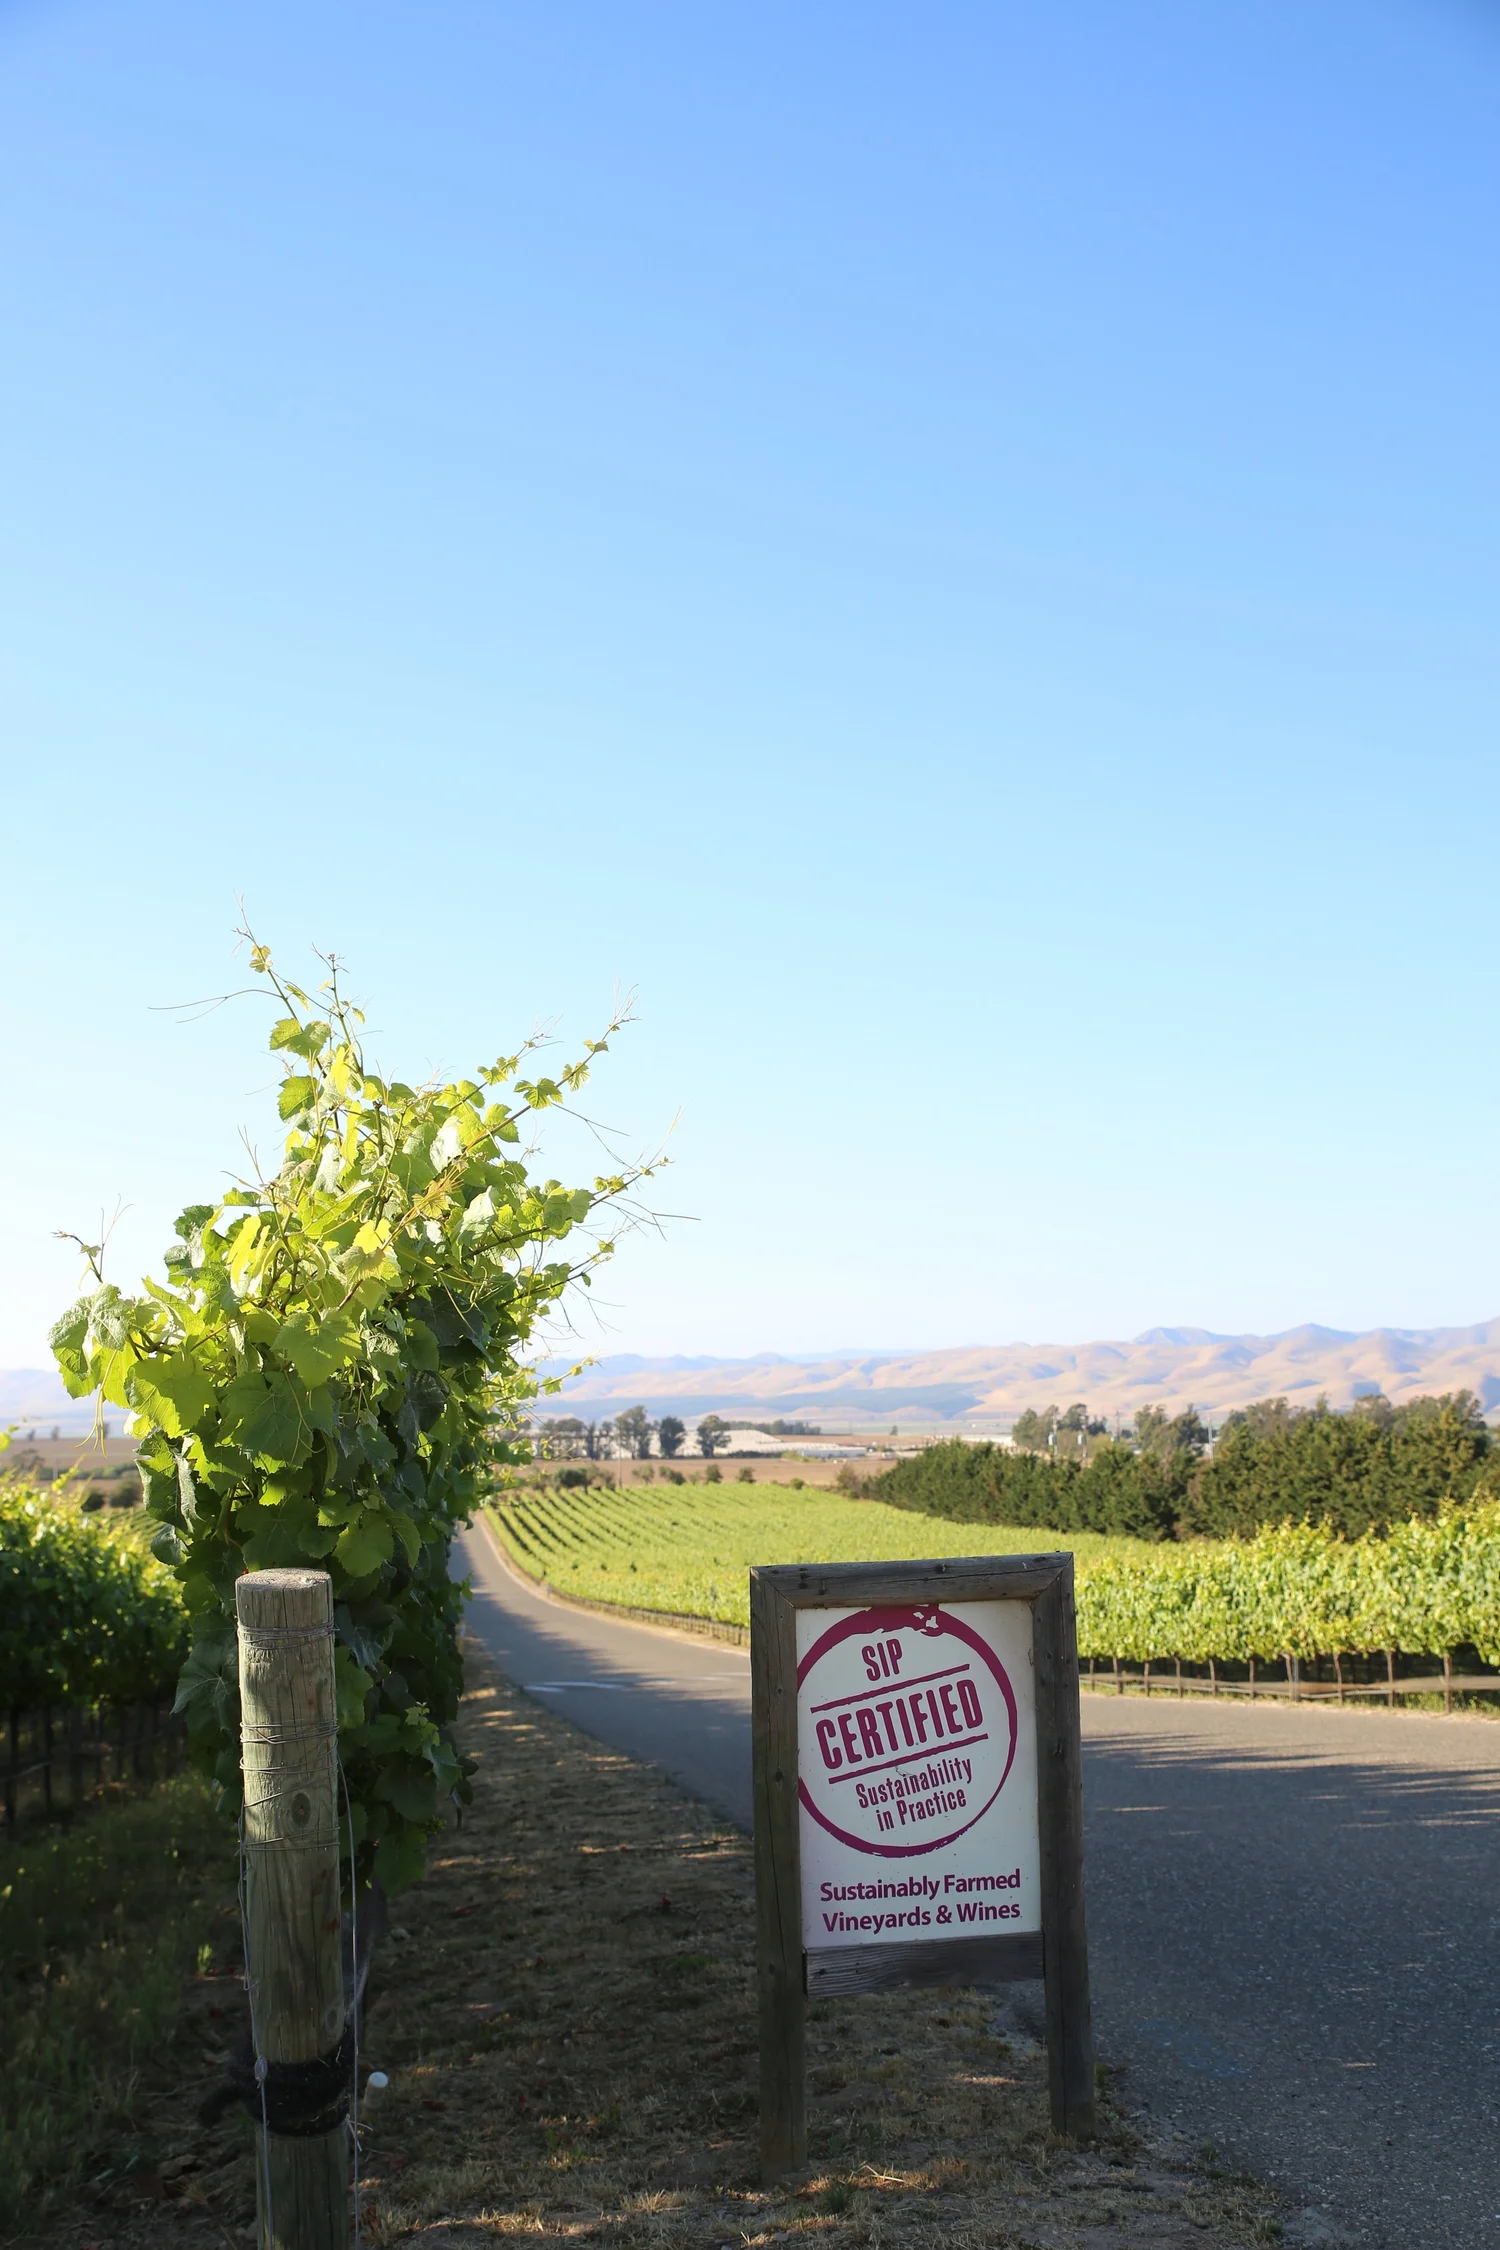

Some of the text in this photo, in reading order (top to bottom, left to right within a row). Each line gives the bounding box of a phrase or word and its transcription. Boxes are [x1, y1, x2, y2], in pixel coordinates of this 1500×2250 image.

[861, 1638, 903, 1682] SIP
[816, 1679, 984, 1770] CERTIFIED
[856, 1757, 973, 1809] Sustainability
[876, 1789, 967, 1832] in Practice
[820, 1868, 1021, 1902] Sustainably Farmed
[822, 1902, 1021, 1934] Vineyards & Wines
